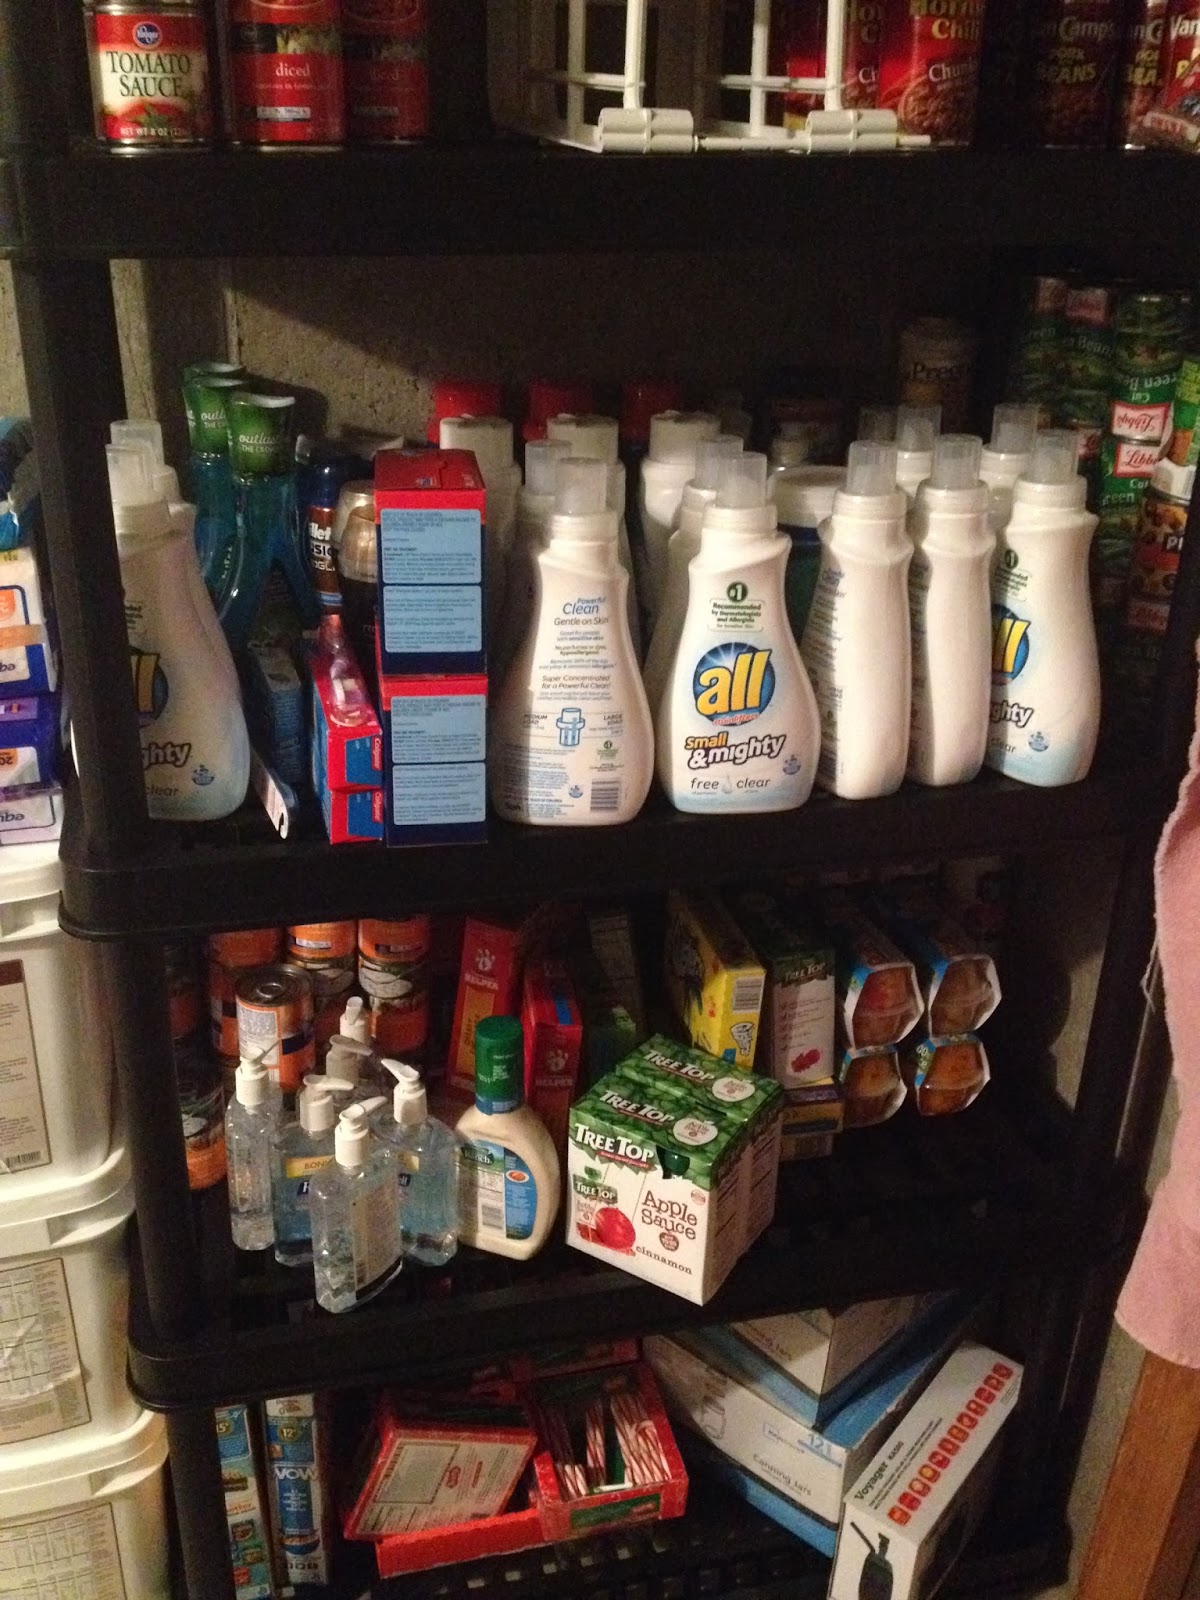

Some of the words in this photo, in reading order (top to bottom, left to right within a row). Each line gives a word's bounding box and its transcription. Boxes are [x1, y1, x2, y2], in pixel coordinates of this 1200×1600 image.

[106, 51, 192, 75] TOMATO
[275, 62, 311, 77] diced
[119, 75, 183, 97] SAUCE
[554, 617, 580, 626] Gentle
[582, 618, 592, 626] on
[594, 617, 609, 625] Skin
[562, 602, 599, 615] Clean
[695, 649, 772, 717] all
[684, 731, 729, 750] small
[690, 777, 720, 790] free
[736, 777, 771, 789] clear
[643, 1049, 683, 1070] TREE
[679, 1062, 716, 1081] TOP
[599, 1089, 641, 1112] TREE
[638, 1102, 676, 1124] TOP
[574, 1123, 616, 1153] TREE
[616, 1136, 655, 1163] TOP
[642, 1190, 698, 1227] Apple
[641, 1208, 697, 1241] Sauce
[635, 1245, 693, 1276] cinnamon
[853, 1460, 889, 1501] Voyager
